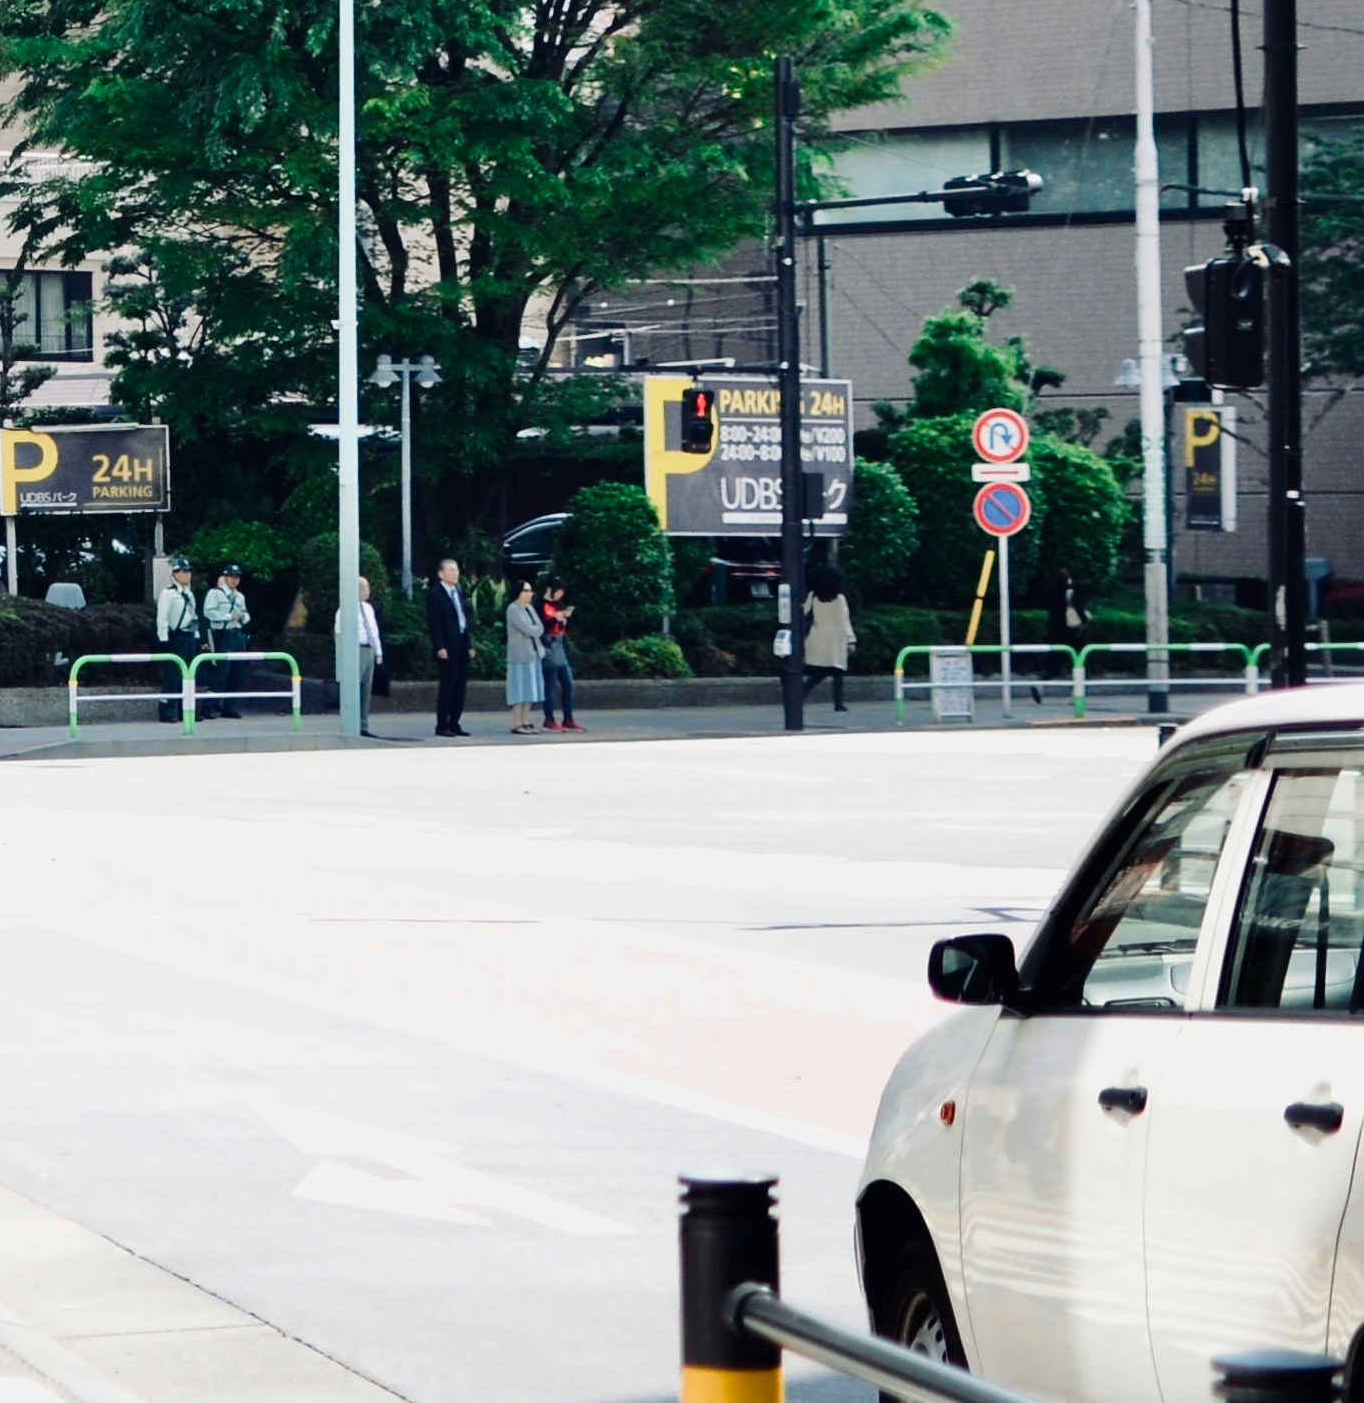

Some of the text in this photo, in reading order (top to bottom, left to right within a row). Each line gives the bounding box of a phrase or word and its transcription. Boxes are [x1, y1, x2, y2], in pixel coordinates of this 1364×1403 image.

[720, 389, 845, 416] PARKI 24H
[1185, 410, 1221, 467] P
[0, 430, 59, 513] P
[92, 454, 153, 483] 24H
[92, 486, 153, 498] PARKING
